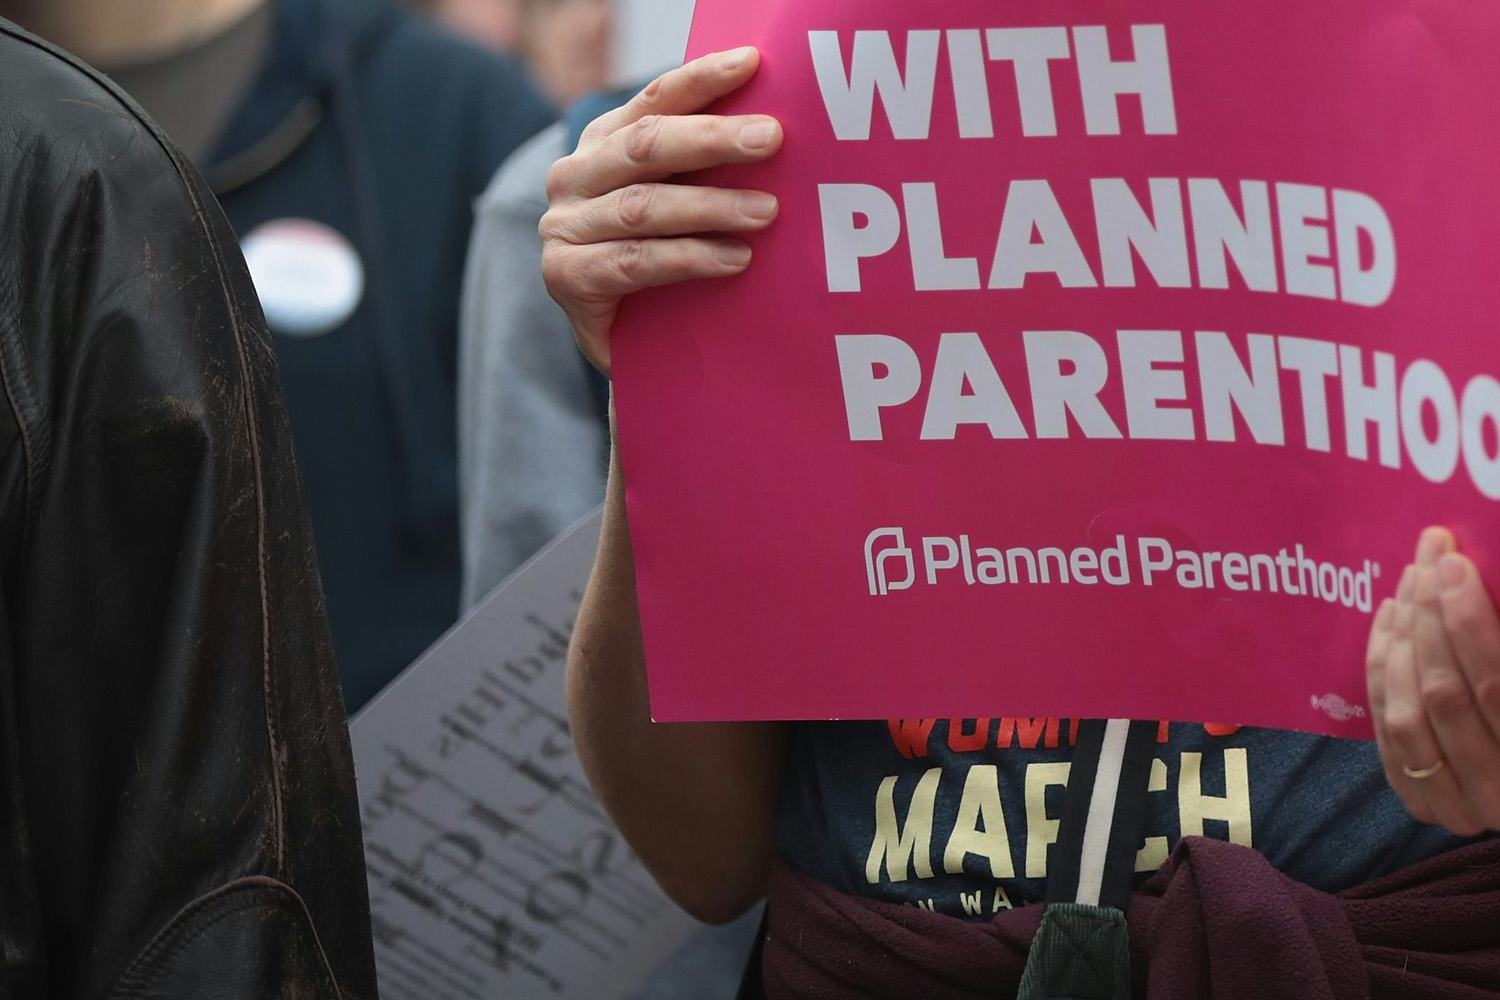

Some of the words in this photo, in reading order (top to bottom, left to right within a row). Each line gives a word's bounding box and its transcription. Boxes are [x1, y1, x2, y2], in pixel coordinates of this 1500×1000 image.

[807, 23, 1179, 141] WITH
[816, 177, 1397, 308] PLANNED
[921, 534, 1131, 586] Planned
[1137, 536, 1374, 614] Parenthood
